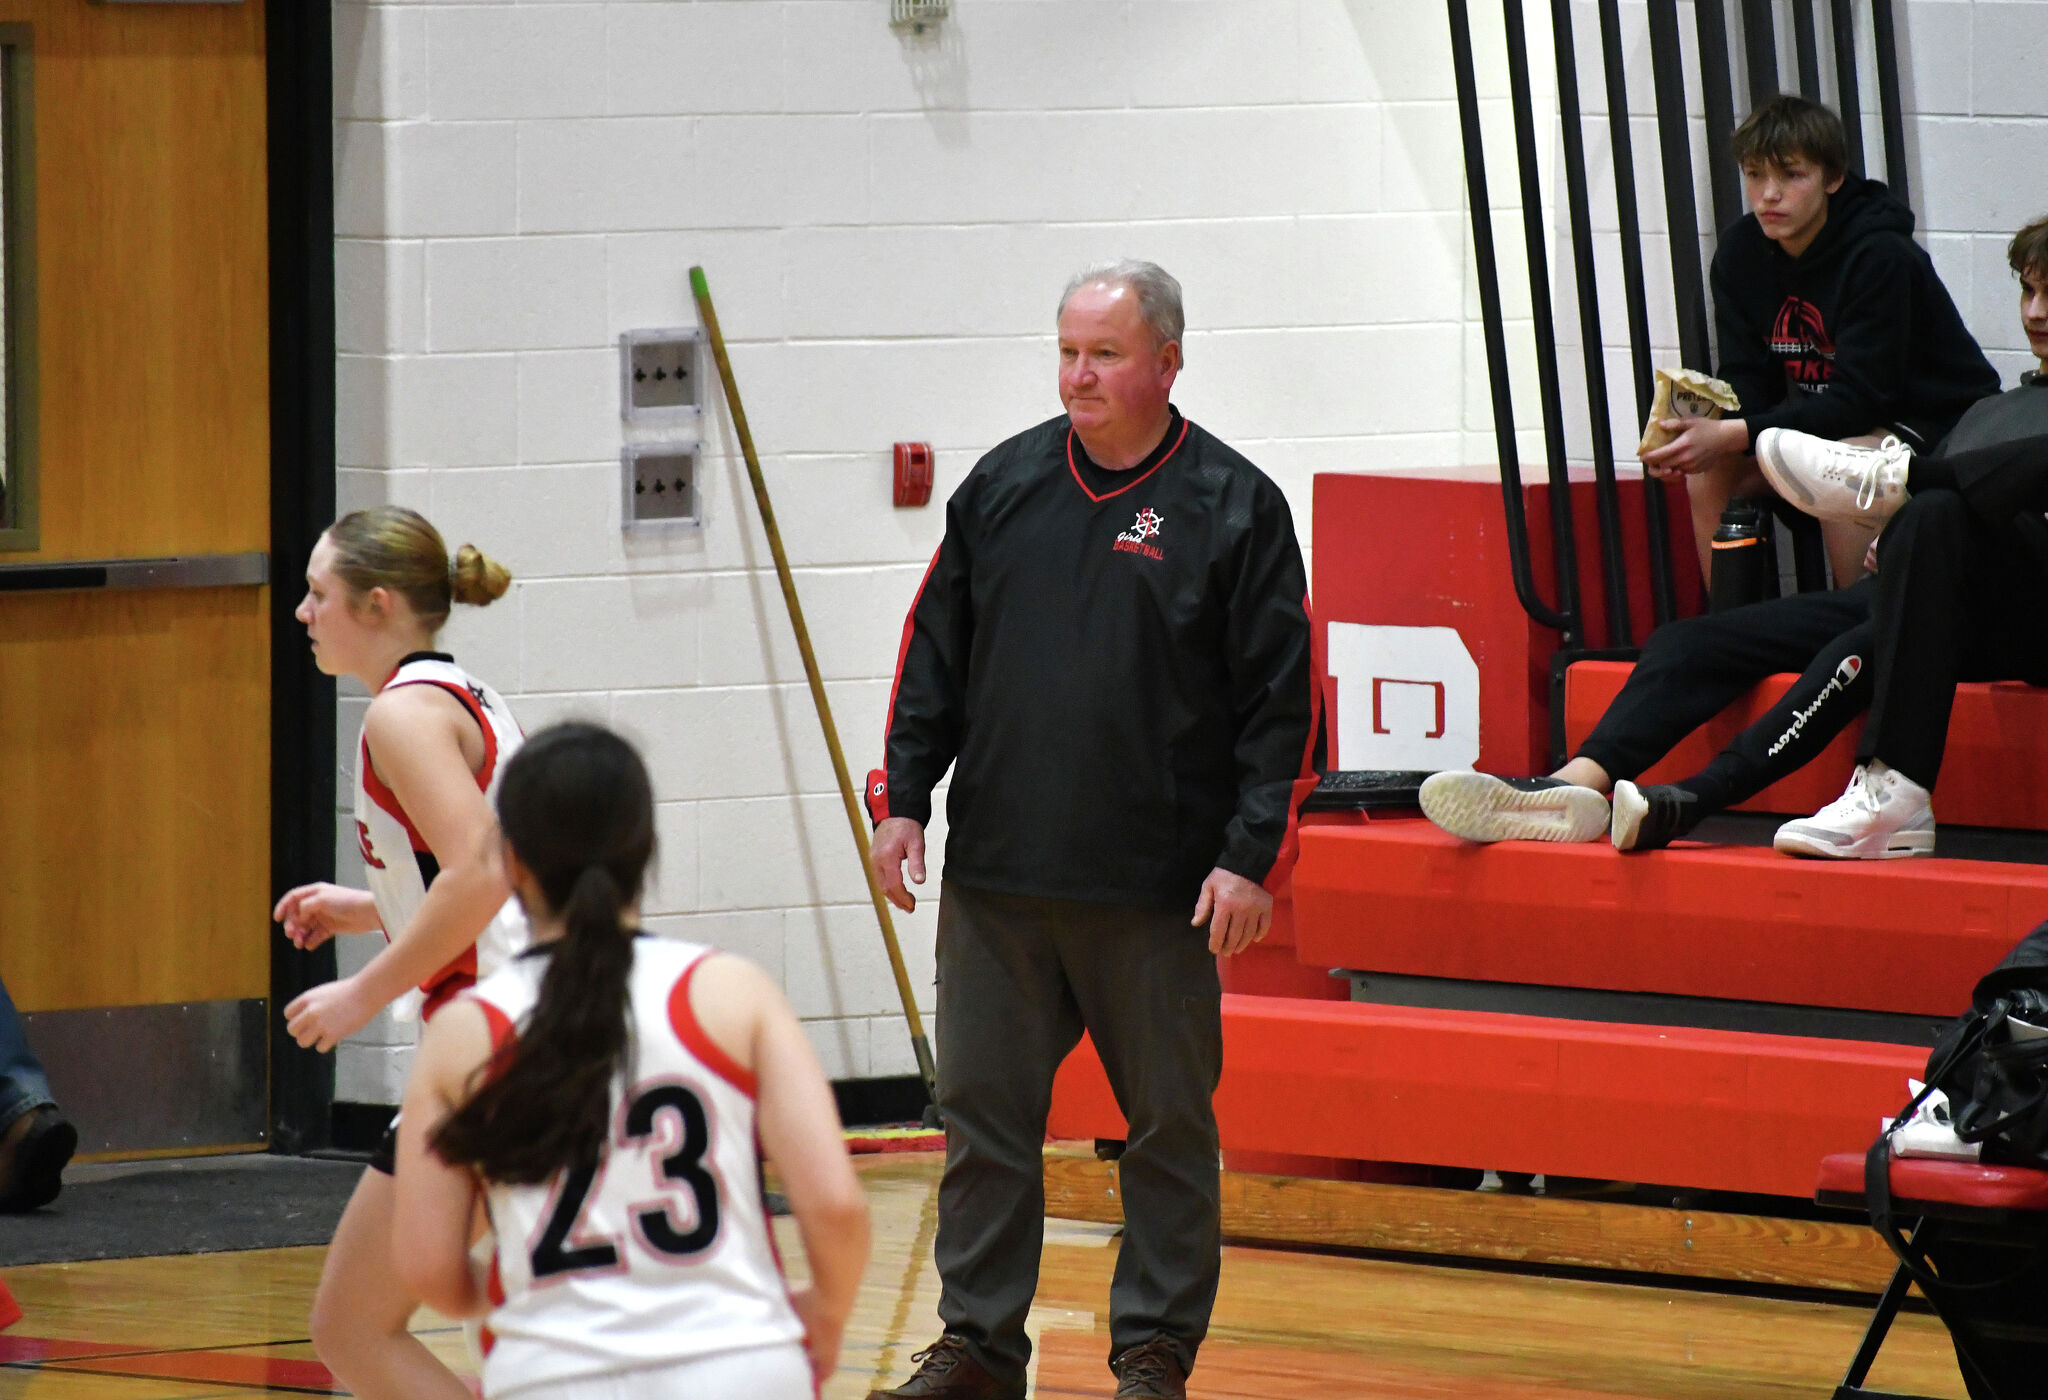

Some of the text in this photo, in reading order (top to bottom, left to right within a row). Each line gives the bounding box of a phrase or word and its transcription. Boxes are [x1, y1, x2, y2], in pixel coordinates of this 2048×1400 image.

[1112, 538, 1164, 561] BASKETBALL
[1767, 654, 1863, 757] Champion
[527, 1073, 731, 1291] 23
